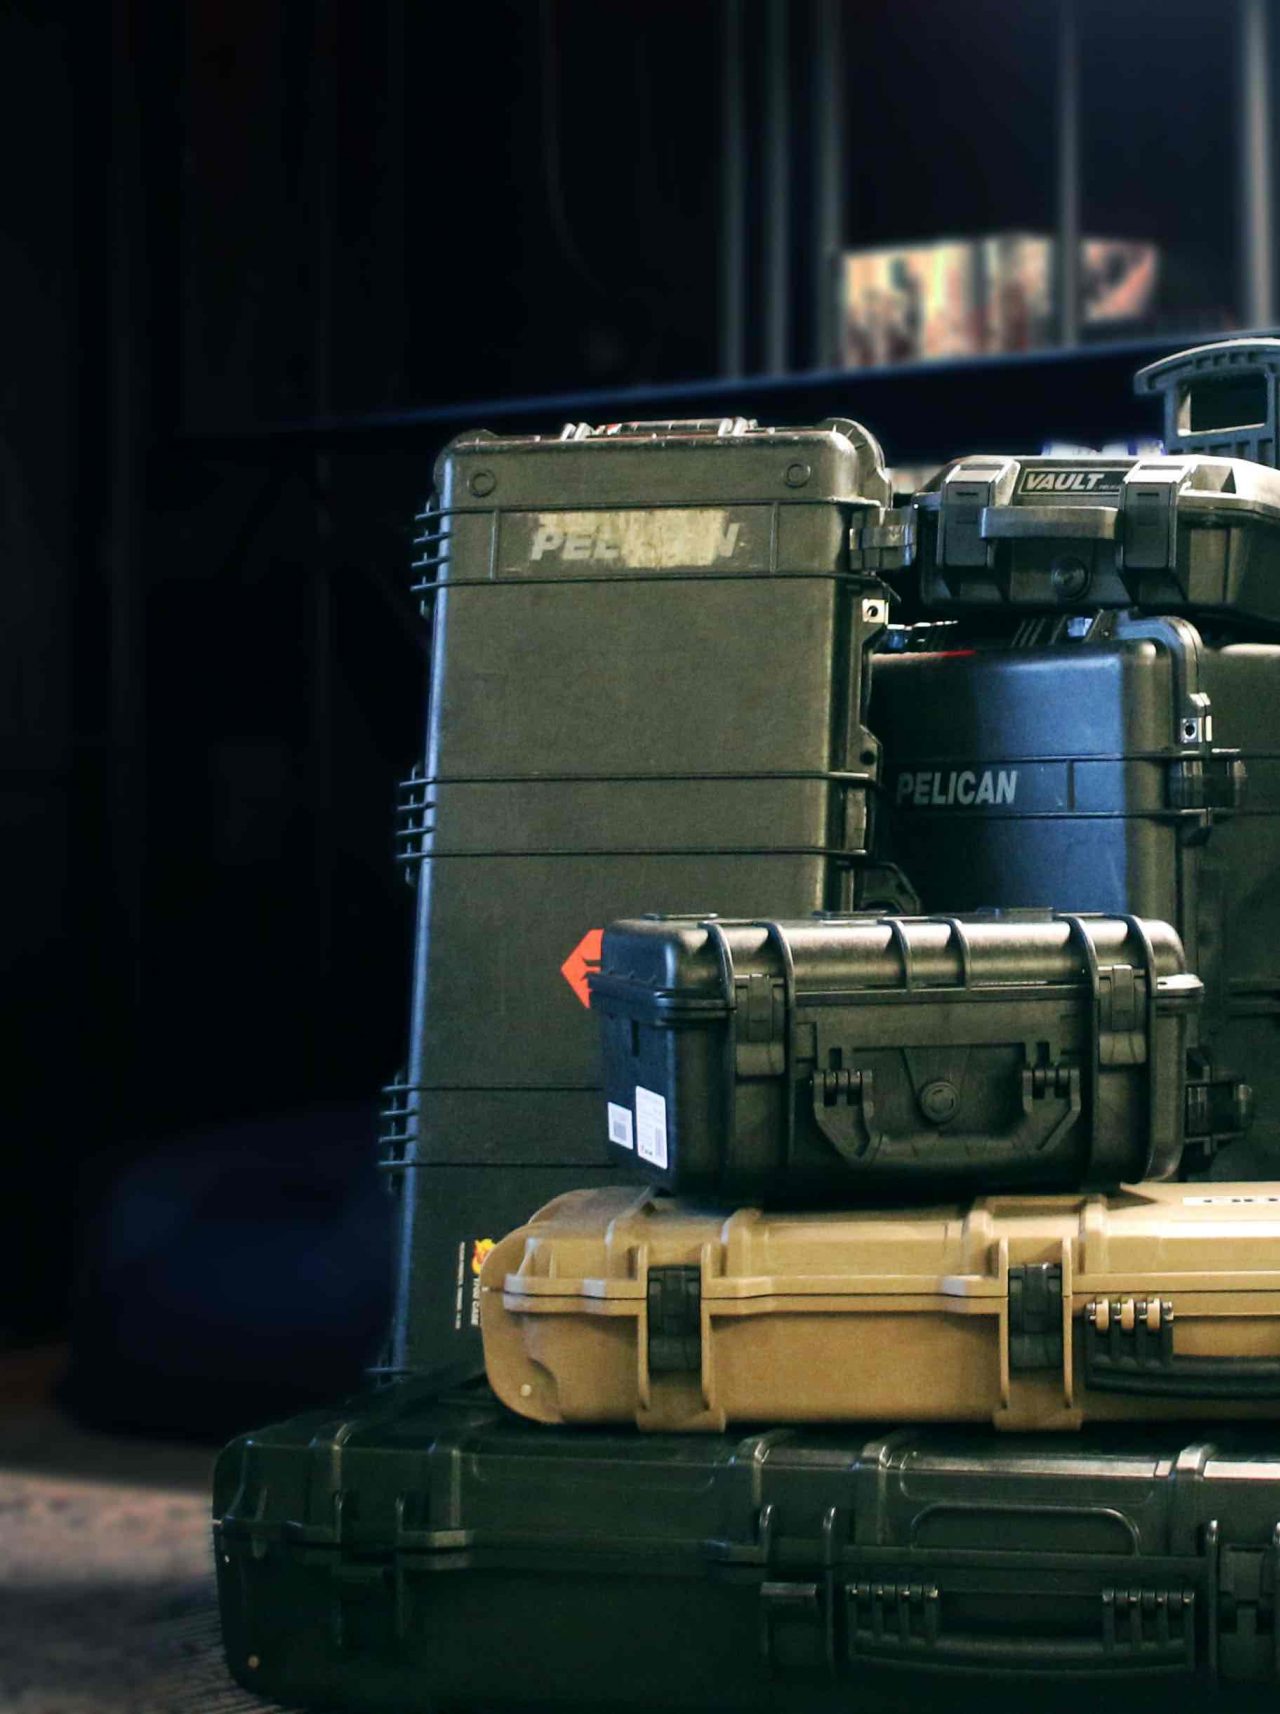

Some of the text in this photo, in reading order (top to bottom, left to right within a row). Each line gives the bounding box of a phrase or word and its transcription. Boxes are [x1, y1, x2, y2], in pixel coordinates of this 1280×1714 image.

[1025, 473, 1105, 491] VAULT
[530, 522, 741, 561] PELN
[897, 770, 1019, 805] PELICAN
